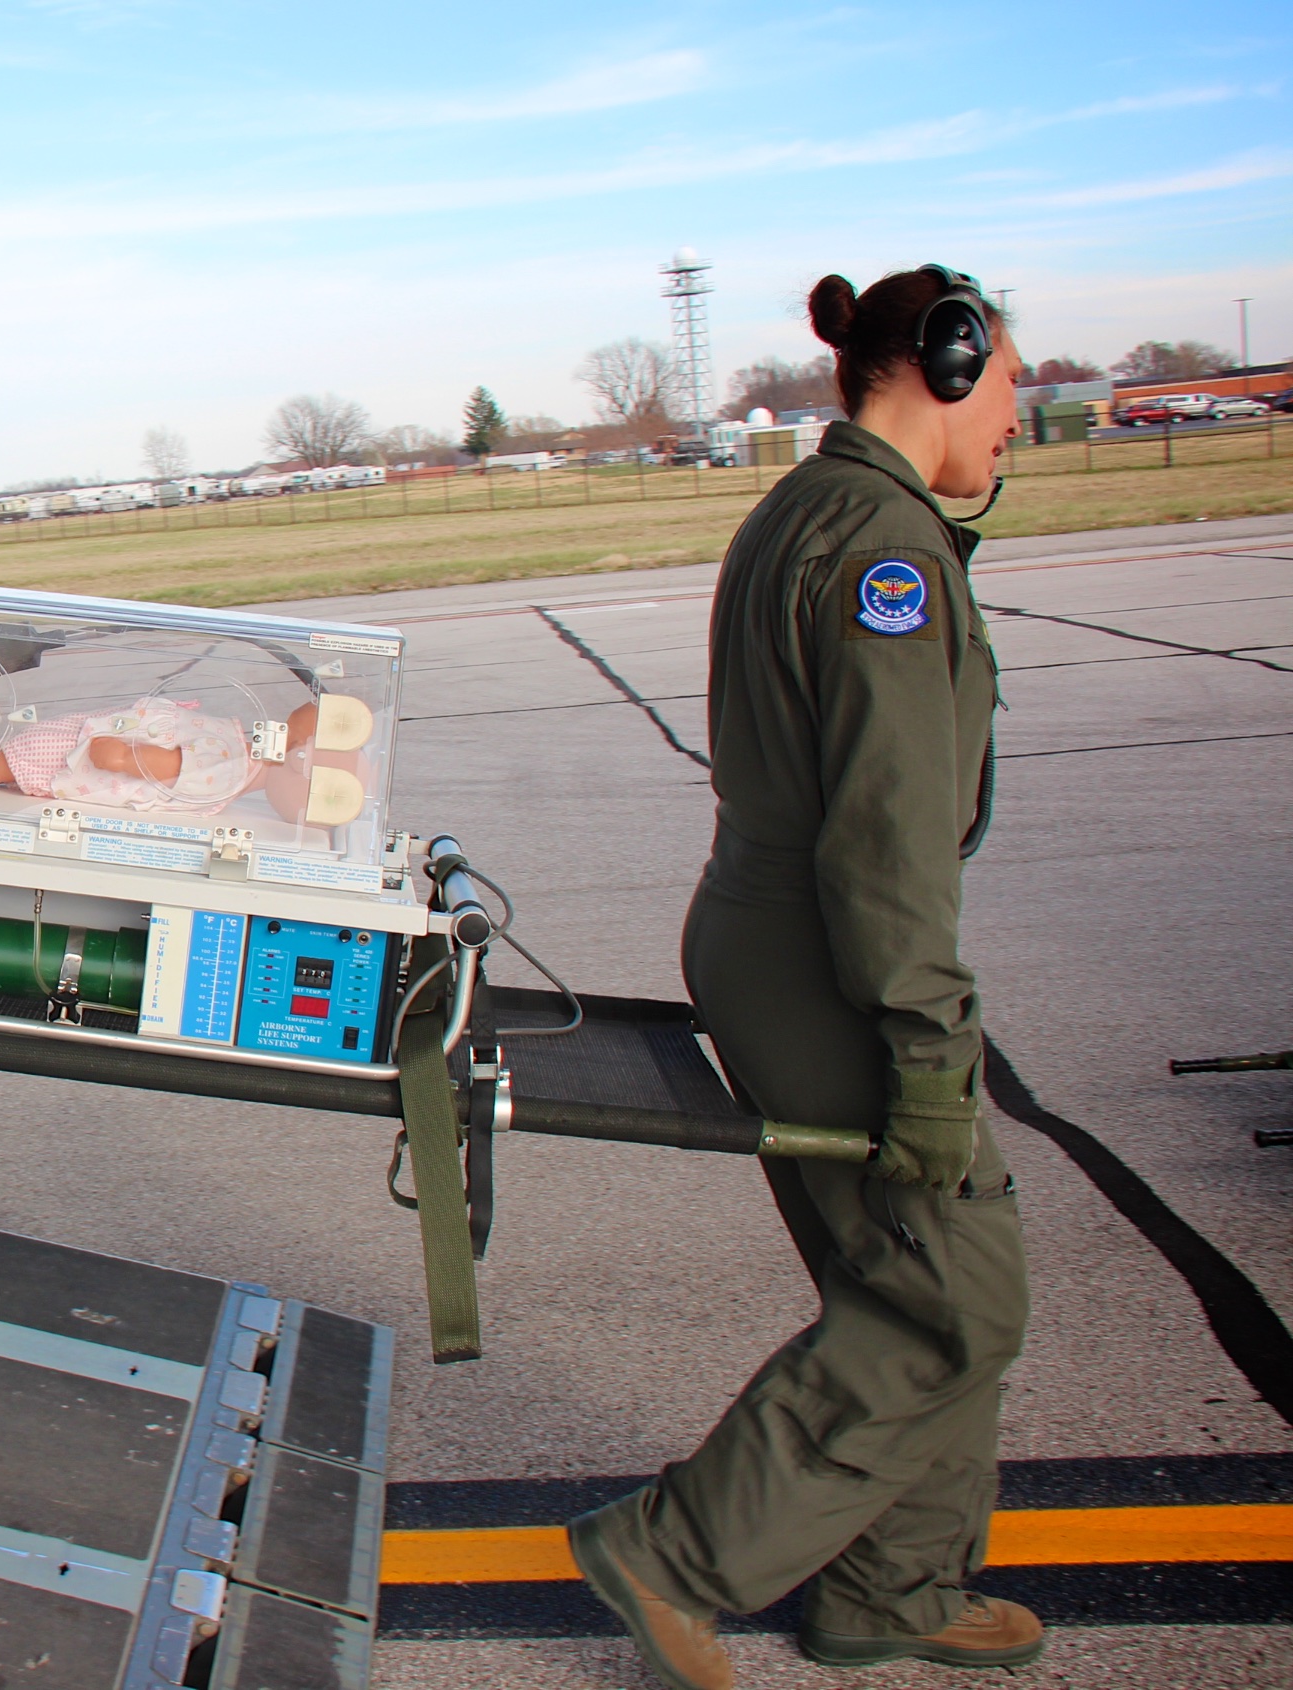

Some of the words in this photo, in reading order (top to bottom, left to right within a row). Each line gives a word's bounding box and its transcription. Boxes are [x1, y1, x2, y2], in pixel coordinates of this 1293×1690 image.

[154, 824, 183, 832] INTENDED
[89, 835, 123, 846] WARNING
[171, 832, 200, 840] SUPPORT
[259, 854, 293, 865] WARNING
[158, 917, 170, 926] FILL
[152, 936, 166, 1009] HUMIDIFIER
[285, 1016, 324, 1026] TEMPERATURE
[260, 1021, 307, 1033] AIRBORNE
[258, 1029, 280, 1039] LIFE
[280, 1031, 323, 1044] SUPPORT
[257, 1037, 299, 1049] SYSTEMS
